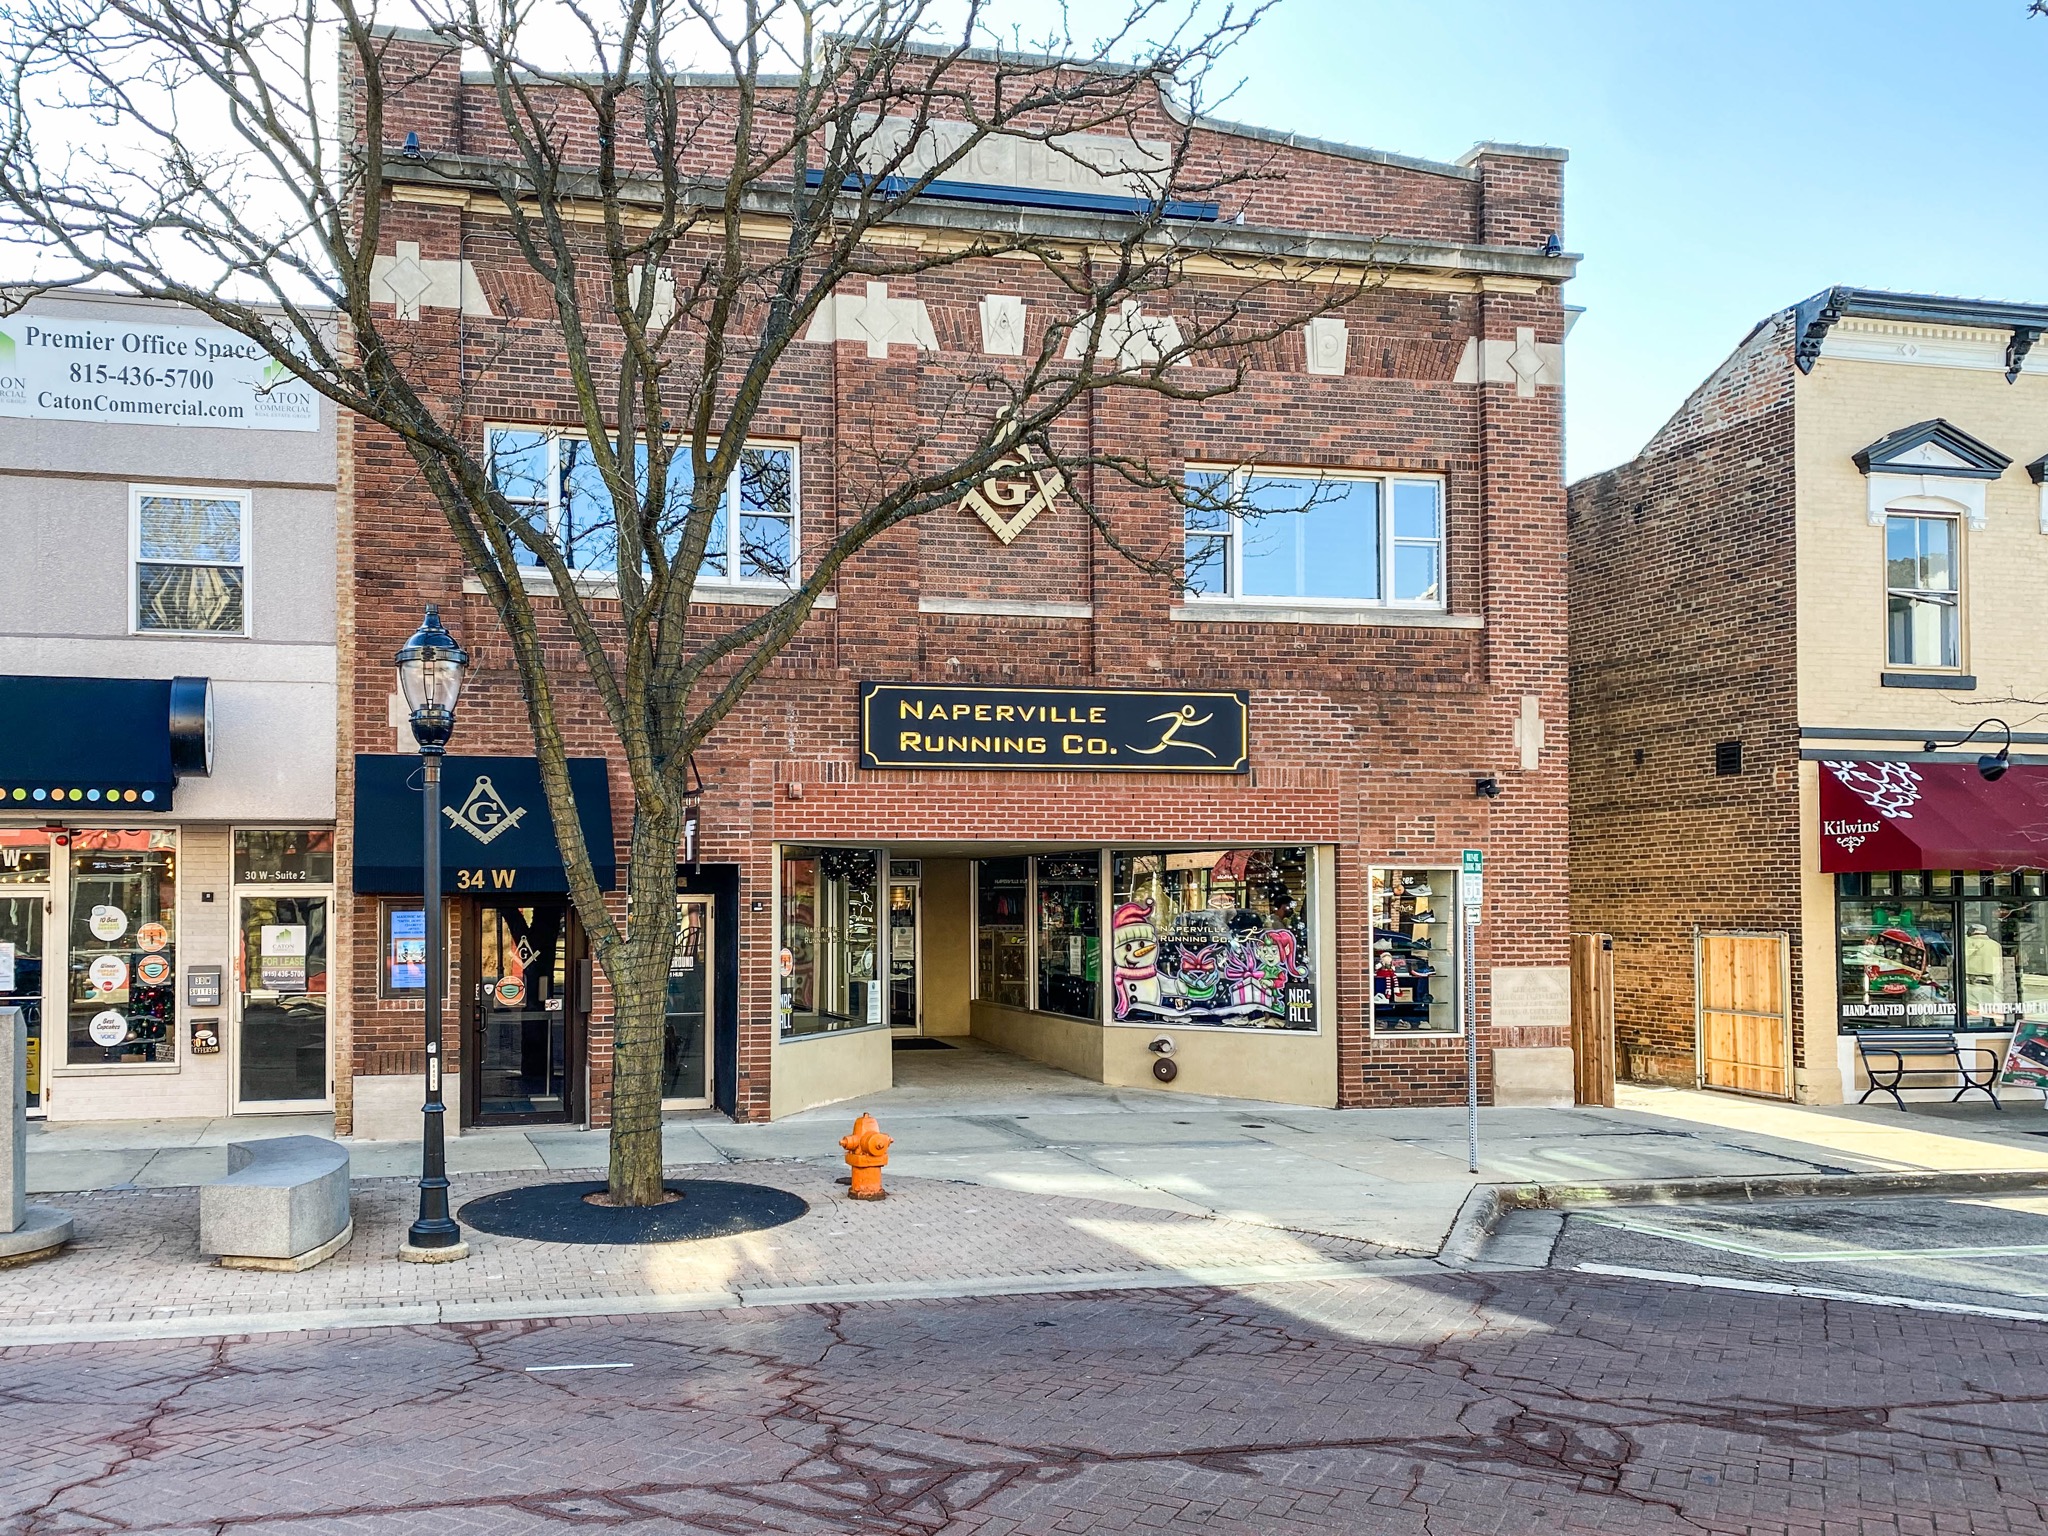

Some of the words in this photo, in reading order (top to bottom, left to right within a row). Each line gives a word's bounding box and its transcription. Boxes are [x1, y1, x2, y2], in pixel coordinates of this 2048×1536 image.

[25, 326, 115, 351] Premier
[122, 333, 187, 356] Office
[195, 337, 256, 362] Space
[69, 362, 214, 390] 815-436-5700
[38, 391, 244, 418] CatonCommercial.com
[254, 392, 311, 405] CATON
[254, 404, 311, 413] COMMERCIAL
[983, 459, 1031, 506] G
[900, 700, 1107, 724] NAPERVILLE
[900, 731, 1047, 754] RUNNING
[1062, 734, 1118, 755] CO.
[468, 802, 501, 825] G
[1823, 819, 1880, 836] Kilwins
[3, 850, 21, 867] W
[245, 871, 256, 880] 30
[300, 870, 306, 880] 2
[457, 869, 485, 889] 34
[491, 869, 516, 889] W
[1160, 935, 1208, 943] RUNNING
[262, 957, 278, 966] FOR
[280, 957, 304, 966] LEASE
[1289, 988, 1311, 1003] NRC
[1289, 1006, 1312, 1022] ALL
[1842, 1004, 1904, 1017] HAND-CRAFTED
[1906, 1003, 1957, 1016] CHOCOLATES
